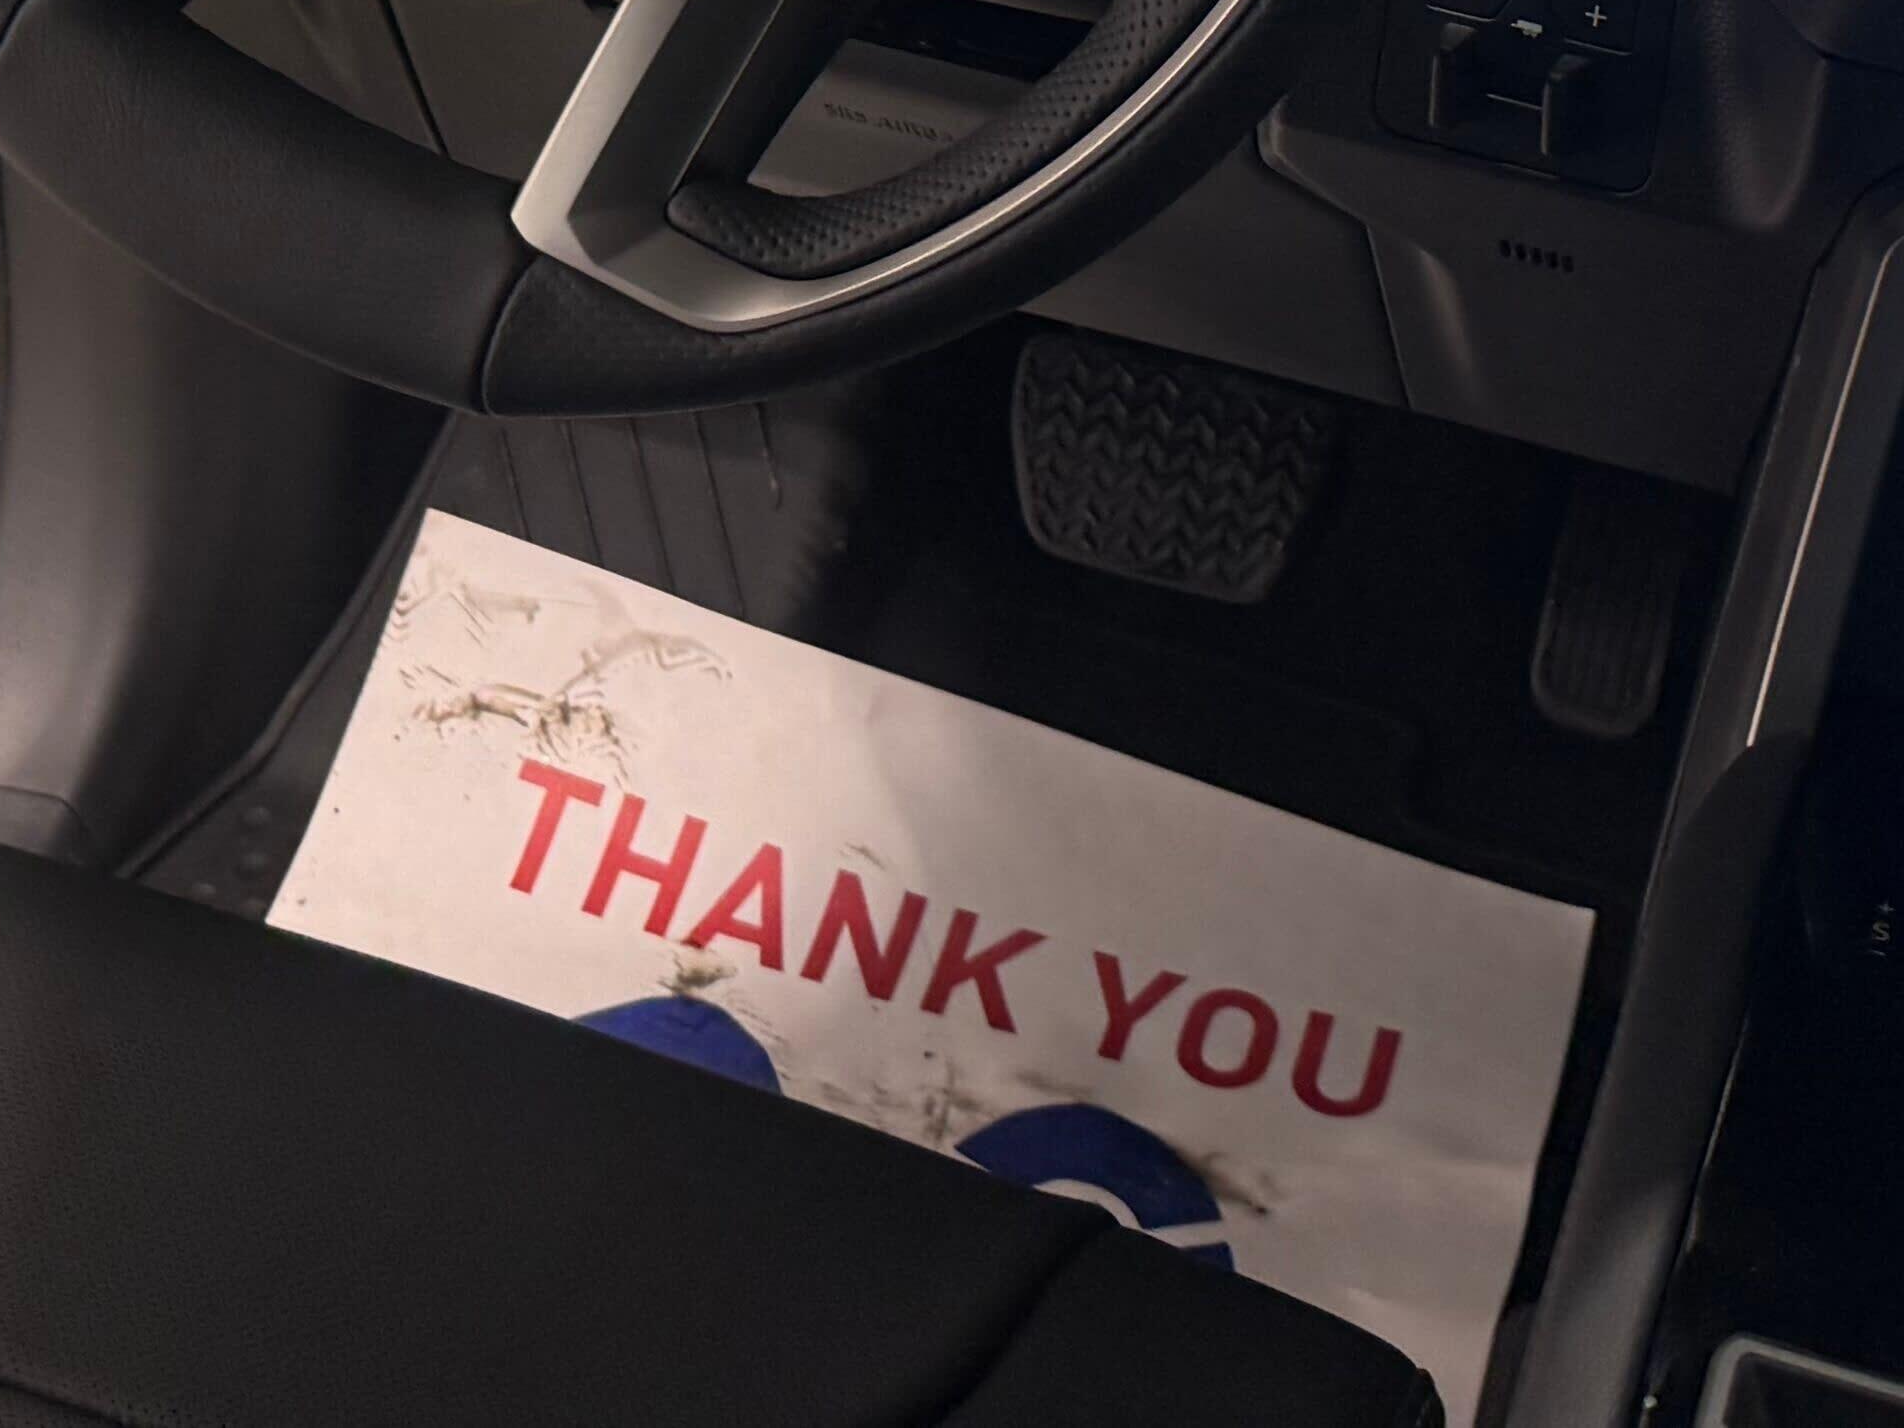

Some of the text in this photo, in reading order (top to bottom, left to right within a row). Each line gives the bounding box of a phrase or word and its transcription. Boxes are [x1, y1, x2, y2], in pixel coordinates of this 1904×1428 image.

[508, 758, 1402, 1119] THANK YOU
[1872, 921, 1891, 942] S
